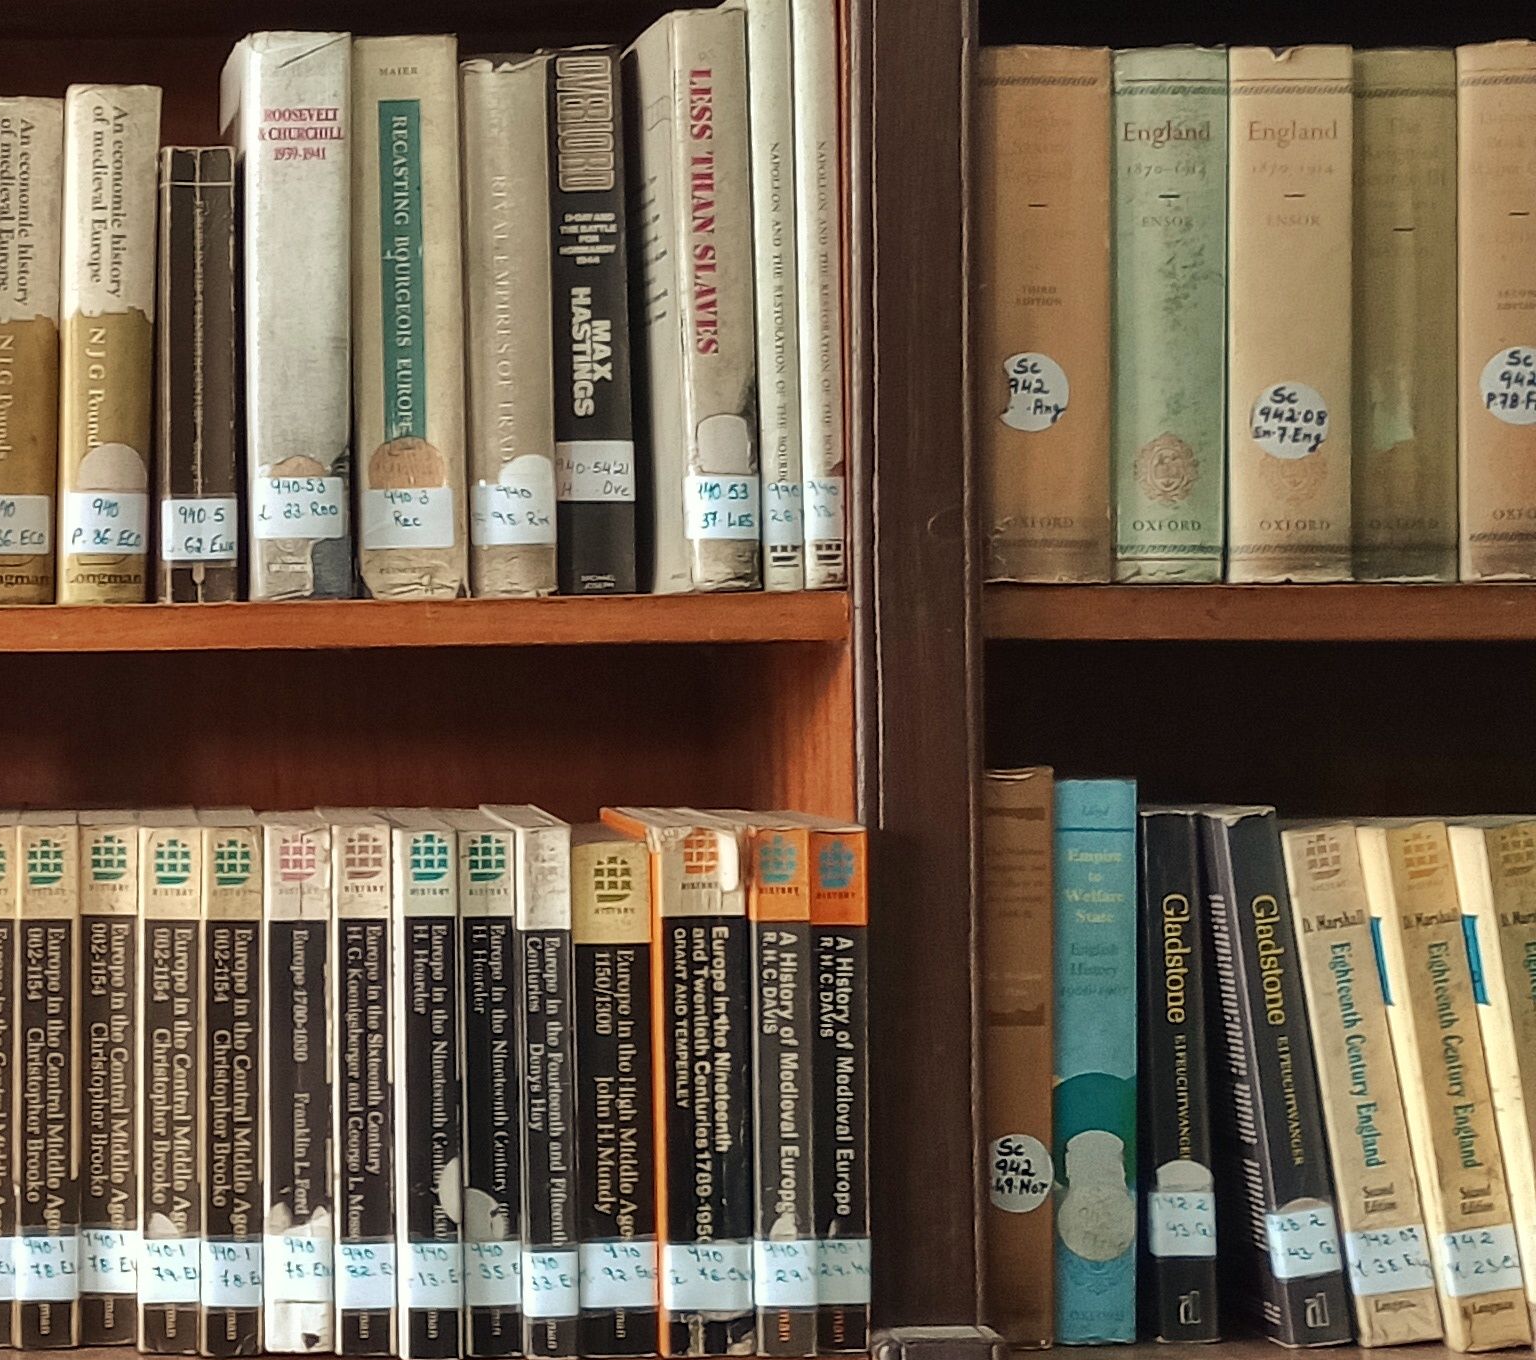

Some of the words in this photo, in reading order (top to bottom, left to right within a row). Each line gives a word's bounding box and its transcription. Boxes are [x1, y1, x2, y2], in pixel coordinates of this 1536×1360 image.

[266, 126, 344, 141] CHURCHILL
[556, 56, 615, 191] OVERLORD
[689, 67, 714, 142] LESS
[1123, 121, 1211, 144] England
[1248, 120, 1338, 143] England
[392, 115, 410, 227] RECASTING
[691, 149, 717, 235] THAN
[393, 235, 412, 351] BOURGEOIS
[692, 242, 720, 357] SLAVES
[571, 286, 594, 418] HASTINGS
[591, 319, 613, 383] MAX
[393, 357, 413, 437] EUROPE
[1132, 518, 1201, 532] OXFORD
[1259, 518, 1331, 532] OXFORD
[1162, 893, 1191, 1024] Gladstone
[1251, 894, 1286, 1027] Gladstone
[1330, 942, 1364, 1030] Eighteenth
[1344, 1033, 1370, 1097] Century
[1355, 1102, 1387, 1169] England
